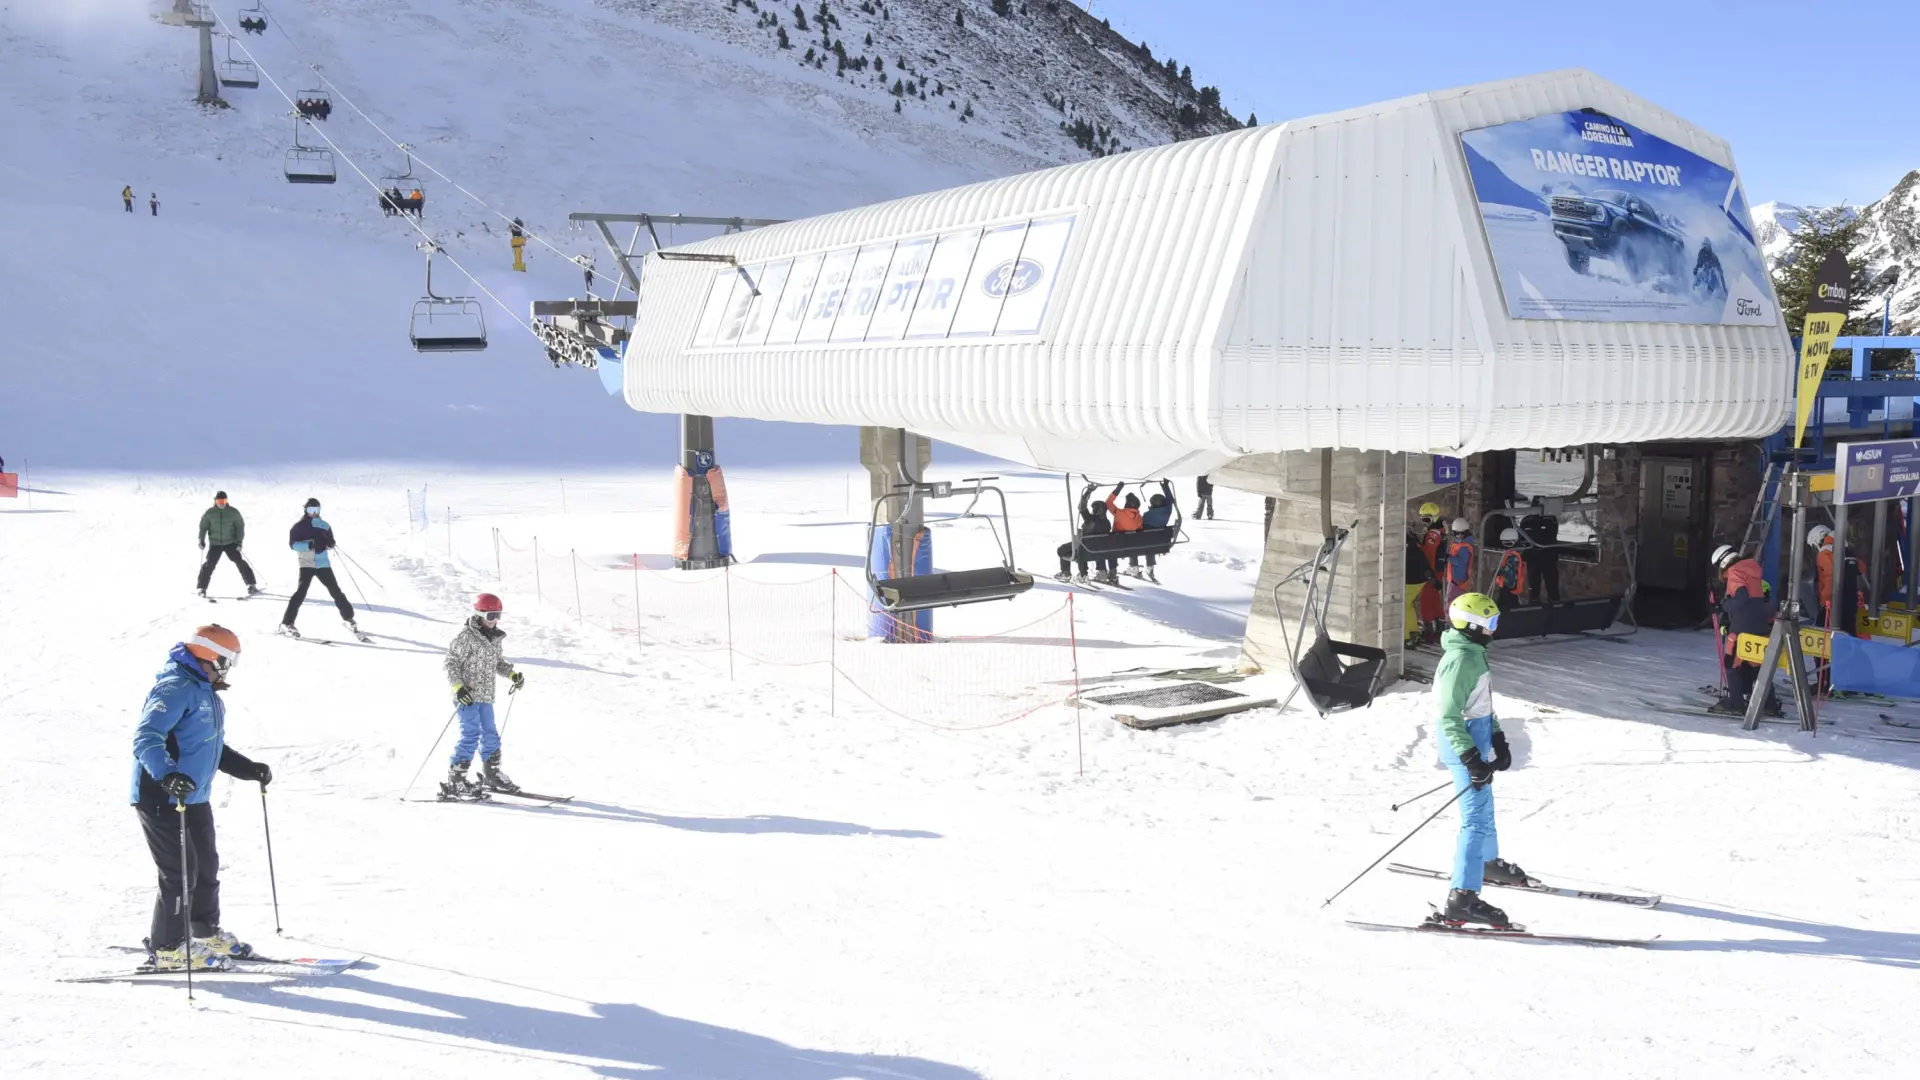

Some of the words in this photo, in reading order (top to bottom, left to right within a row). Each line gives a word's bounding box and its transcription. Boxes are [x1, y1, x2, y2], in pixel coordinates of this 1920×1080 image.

[1584, 121, 1610, 134] CAMINO
[1616, 126, 1625, 135] LA
[1582, 130, 1634, 147] ADRENALINA
[1530, 148, 1610, 179] RANGER
[1737, 298, 1762, 316] Ford
[1809, 321, 1830, 336] FIBRA
[1806, 341, 1829, 356] MÓVIL
[1804, 366, 1810, 379] &
[1810, 363, 1819, 377] TV
[1745, 641, 1767, 654] ST
[1577, 891, 1649, 906] HEAD
